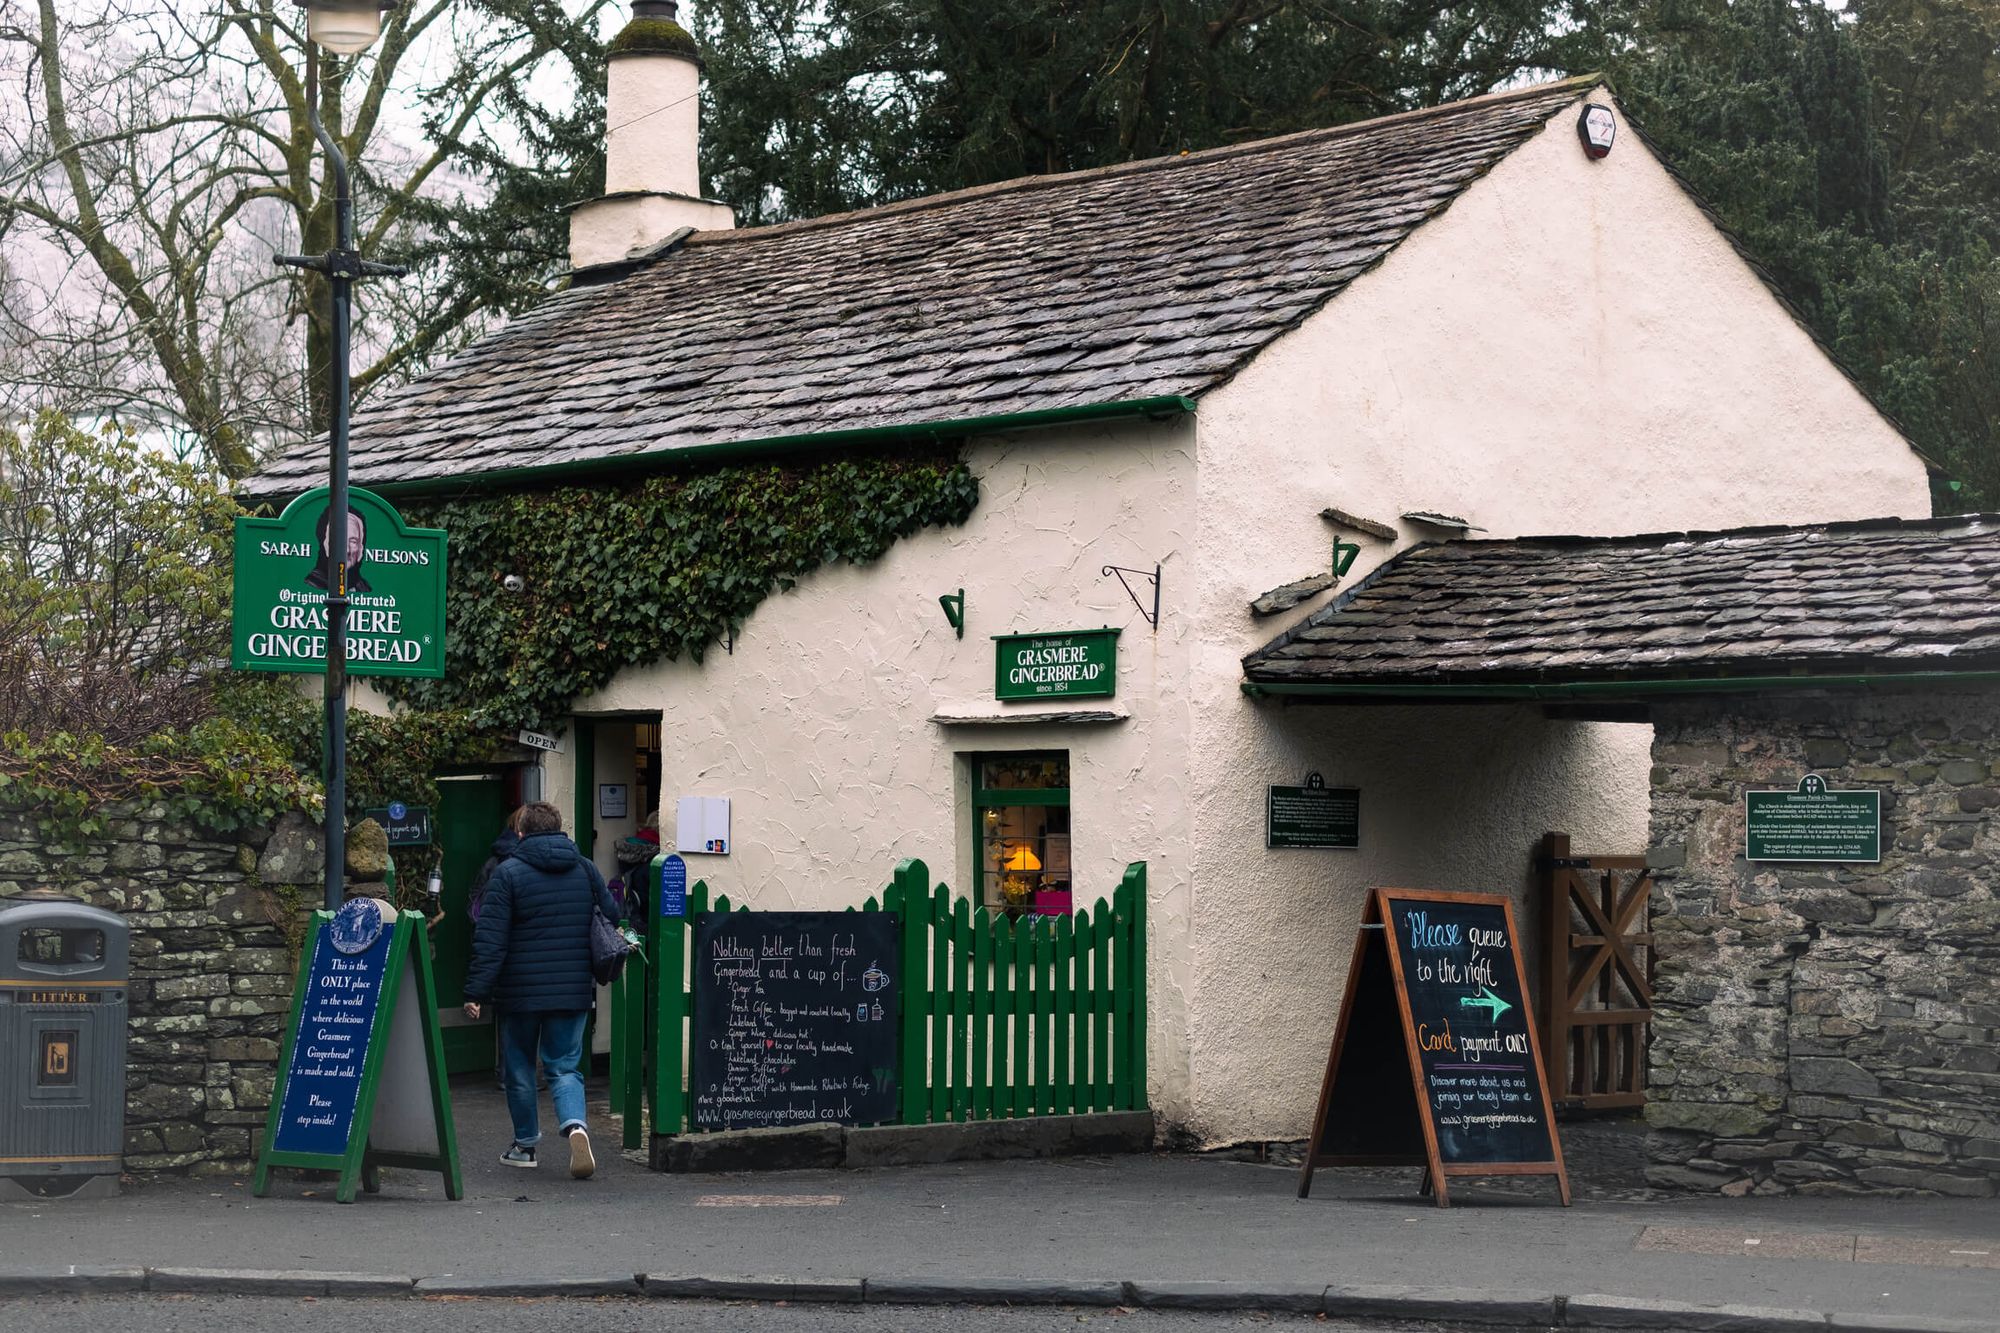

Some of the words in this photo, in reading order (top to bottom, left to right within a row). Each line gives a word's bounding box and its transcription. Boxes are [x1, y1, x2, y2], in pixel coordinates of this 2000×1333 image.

[260, 541, 311, 557] SARAH
[365, 549, 429, 565] NELSON'S
[280, 589, 329, 606] Original
[346, 595, 396, 607] lebrated
[248, 633, 432, 663] GINGEBREAD®
[1017, 646, 1088, 666] GRASMERE
[1036, 684, 1052, 692] since
[1054, 682, 1068, 692] 1854
[527, 735, 557, 749] OPEN
[1407, 908, 1462, 949] Please
[1468, 927, 1507, 961] queue
[713, 936, 755, 966] Nothing
[761, 936, 794, 958] better
[799, 934, 822, 957] than
[830, 934, 857, 965] fresh
[331, 959, 347, 971] This
[349, 961, 355, 971] is
[356, 959, 369, 971] the
[714, 960, 761, 985] Gingerbread
[769, 960, 789, 983] and
[793, 971, 801, 983] a
[808, 971, 826, 990] cup
[1416, 958, 1432, 981] to
[1437, 958, 1461, 984] the
[1464, 958, 1498, 997] right
[321, 976, 350, 989] ONLY
[351, 979, 371, 993] place
[754, 980, 766, 994] Tea
[32, 992, 87, 1002] LITTER
[321, 997, 329, 1005] in
[329, 997, 342, 1005] the
[342, 995, 363, 1006] world
[731, 999, 750, 1012] Fresh
[830, 1005, 851, 1023] locally
[312, 1014, 332, 1024] where
[333, 1013, 364, 1024] delicious
[729, 1014, 757, 1027] Lakeland
[763, 1015, 774, 1027] Tea
[318, 1029, 352, 1042] Grasmere
[728, 1028, 748, 1041] Ginger
[1419, 1017, 1457, 1053] Card
[1460, 1030, 1503, 1061] payment
[1505, 1034, 1528, 1054] ONLY
[740, 1039, 766, 1055] yourself
[775, 1040, 782, 1050] to
[796, 1040, 817, 1056] locally
[821, 1041, 855, 1055] handmade
[728, 1052, 758, 1064] Lakeland
[764, 1053, 797, 1065] chocolates
[297, 1067, 303, 1075] is
[304, 1067, 322, 1075] made
[323, 1067, 338, 1076] and
[338, 1067, 356, 1077] sold.
[753, 1062, 776, 1076] Truffles
[727, 1073, 747, 1087] Ginger
[751, 1072, 775, 1087] Truffles
[1430, 1075, 1457, 1086] Discover
[1460, 1078, 1477, 1086] more
[1479, 1076, 1499, 1087] about
[1501, 1079, 1510, 1087] us
[1513, 1077, 1526, 1087] and
[741, 1081, 767, 1098] yourself
[772, 1081, 787, 1092] with
[309, 1095, 332, 1108] Please
[716, 1093, 743, 1108] goodies
[1434, 1090, 1461, 1110] joining
[1463, 1093, 1475, 1101] our
[1477, 1090, 1500, 1110] lovely
[1500, 1089, 1520, 1101] team
[297, 1114, 312, 1127] step
[312, 1113, 337, 1126] inside!
